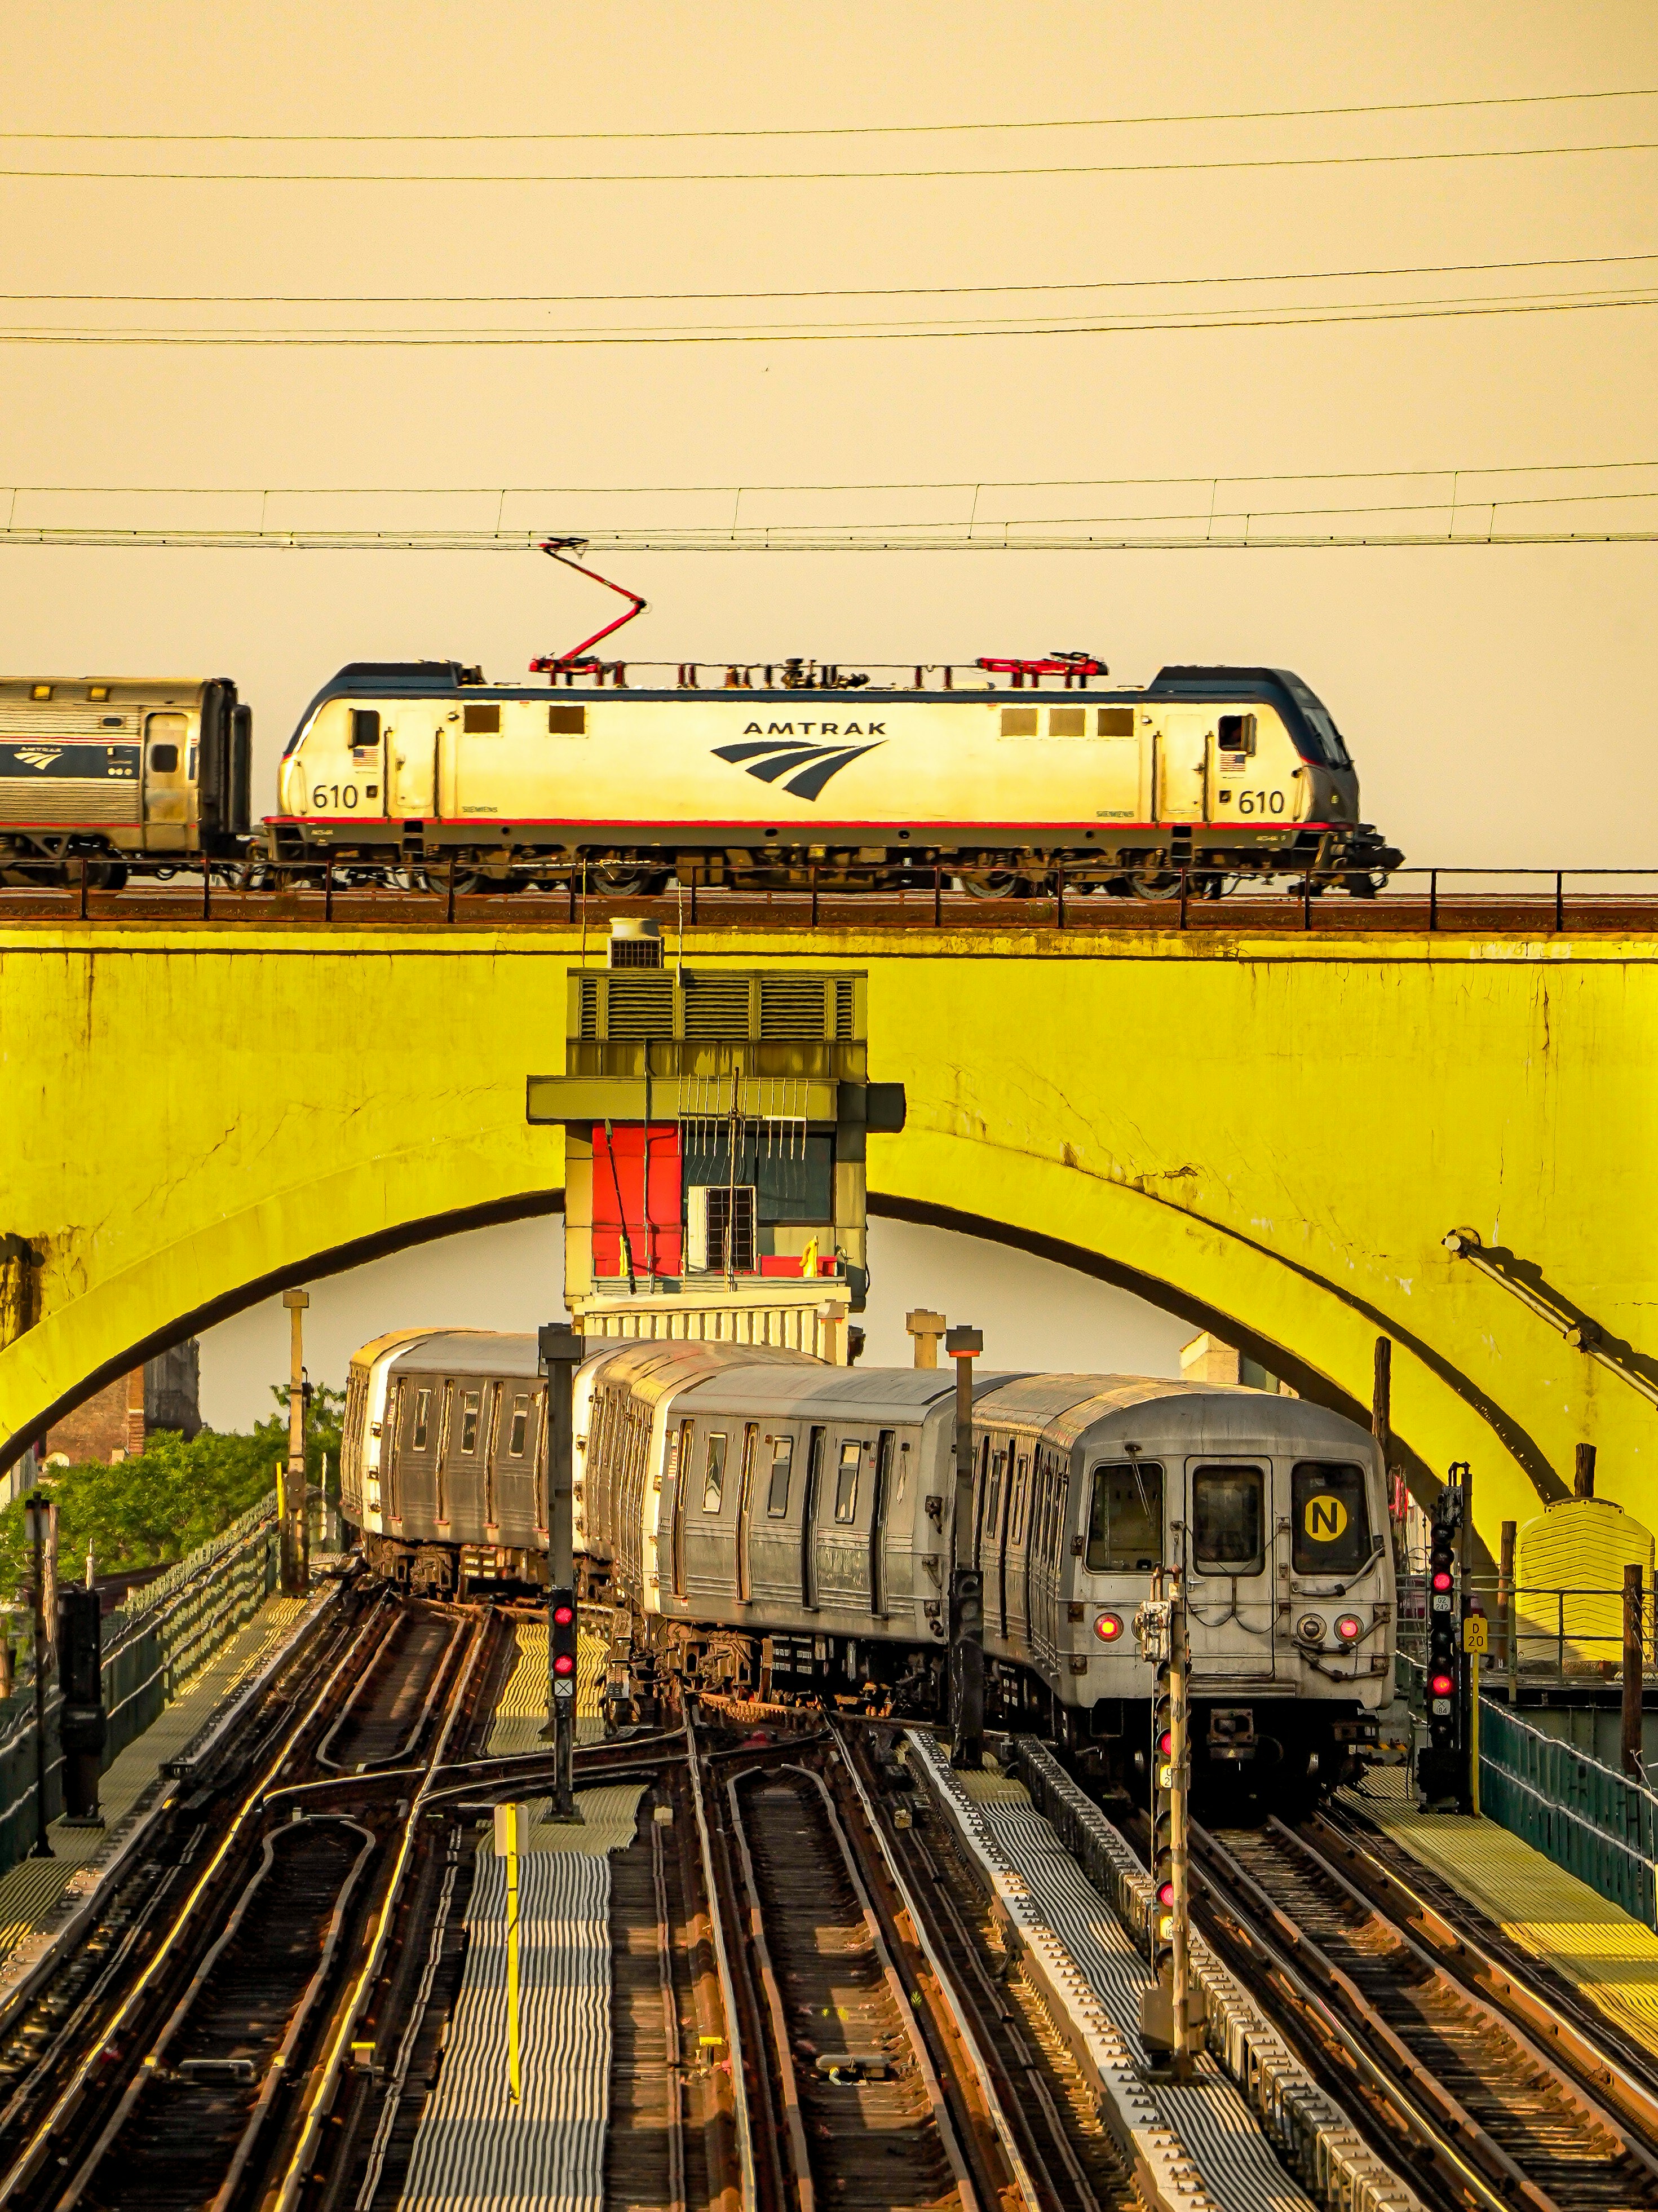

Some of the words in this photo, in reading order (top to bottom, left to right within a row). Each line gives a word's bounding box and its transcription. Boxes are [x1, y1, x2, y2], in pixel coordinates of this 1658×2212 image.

[742, 722, 887, 735] AMTRAK
[313, 784, 358, 809] 610
[1239, 791, 1285, 814] 610
[1312, 1502, 1338, 1534] N
[1473, 1623, 1480, 1634] D
[1467, 1636, 1484, 1647] 20
